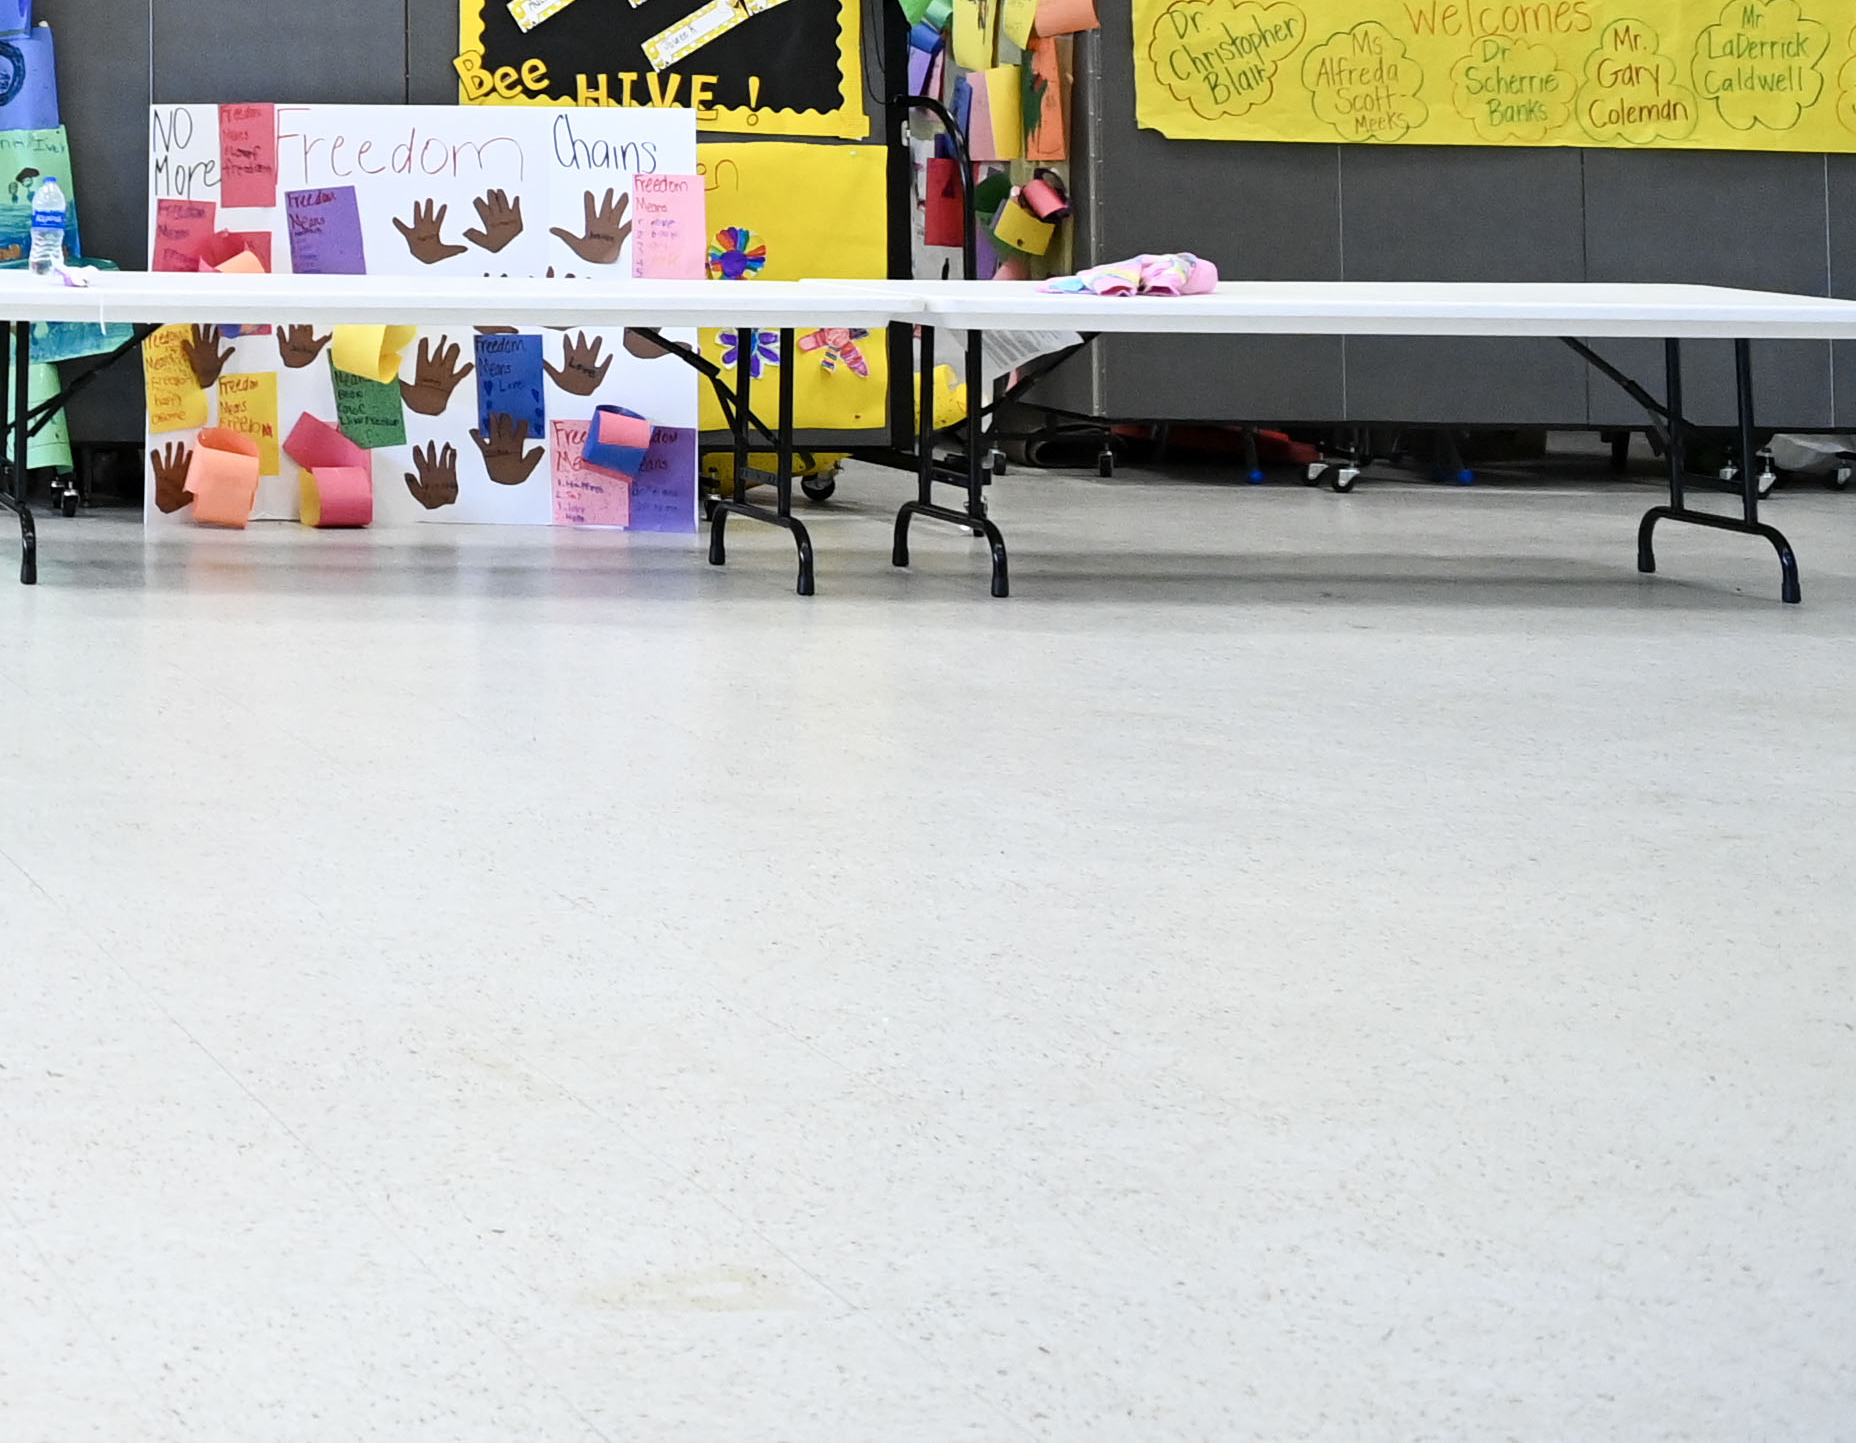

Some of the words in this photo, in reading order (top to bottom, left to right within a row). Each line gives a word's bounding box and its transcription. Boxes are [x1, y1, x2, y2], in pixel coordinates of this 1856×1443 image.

[1169, 14, 1299, 81] Christopher
[1708, 30, 1810, 59] LaDerrick
[453, 50, 550, 100] Bee
[1203, 66, 1267, 106] Blair
[1316, 57, 1399, 88] Alfreda
[1465, 65, 1559, 95] Scherrie
[1597, 57, 1660, 96] Gary
[1704, 65, 1802, 94] Caldwell
[1486, 98, 1548, 126] Banks
[1588, 98, 1689, 129] Coleman
[153, 107, 193, 153] NO
[275, 107, 524, 185] Freedom
[553, 113, 658, 174] Chains
[154, 154, 222, 201] More
[634, 174, 688, 194] Freedom
[635, 197, 668, 213] Means
[475, 337, 527, 354] Freedom
[567, 356, 596, 379] Love
[498, 380, 524, 392] Love
